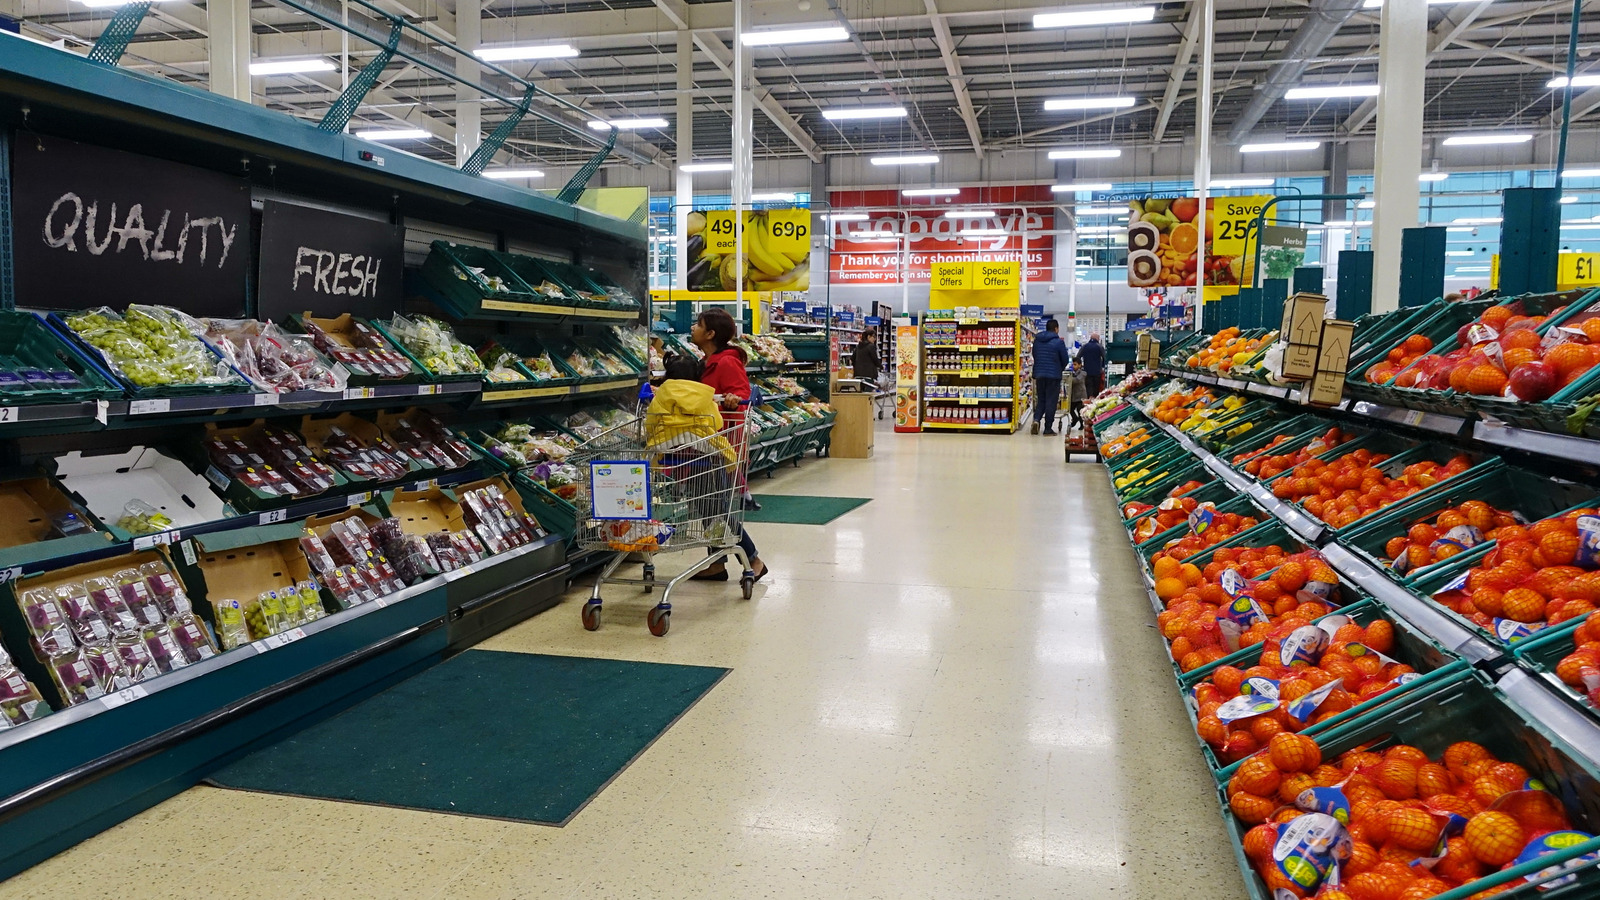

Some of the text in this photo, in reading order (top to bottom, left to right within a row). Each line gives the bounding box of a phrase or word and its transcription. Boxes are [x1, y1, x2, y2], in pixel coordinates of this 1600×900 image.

[1227, 203, 1261, 216] Save
[42, 192, 238, 268] QUALITY
[772, 221, 807, 241] 69p
[1283, 237, 1303, 246] Herbs
[840, 251, 1043, 268] Thank you for shopping with us
[293, 246, 382, 298] FRESH
[938, 266, 965, 276] Special
[982, 266, 1011, 276] Special
[1575, 257, 1593, 279] £1
[839, 271, 883, 279] Remember
[939, 277, 963, 286] Offers
[983, 277, 1009, 286] Offers
[269, 511, 280, 522] £2
[152, 536, 163, 546] £2
[278, 633, 292, 644] £2
[119, 688, 139, 702] £2
